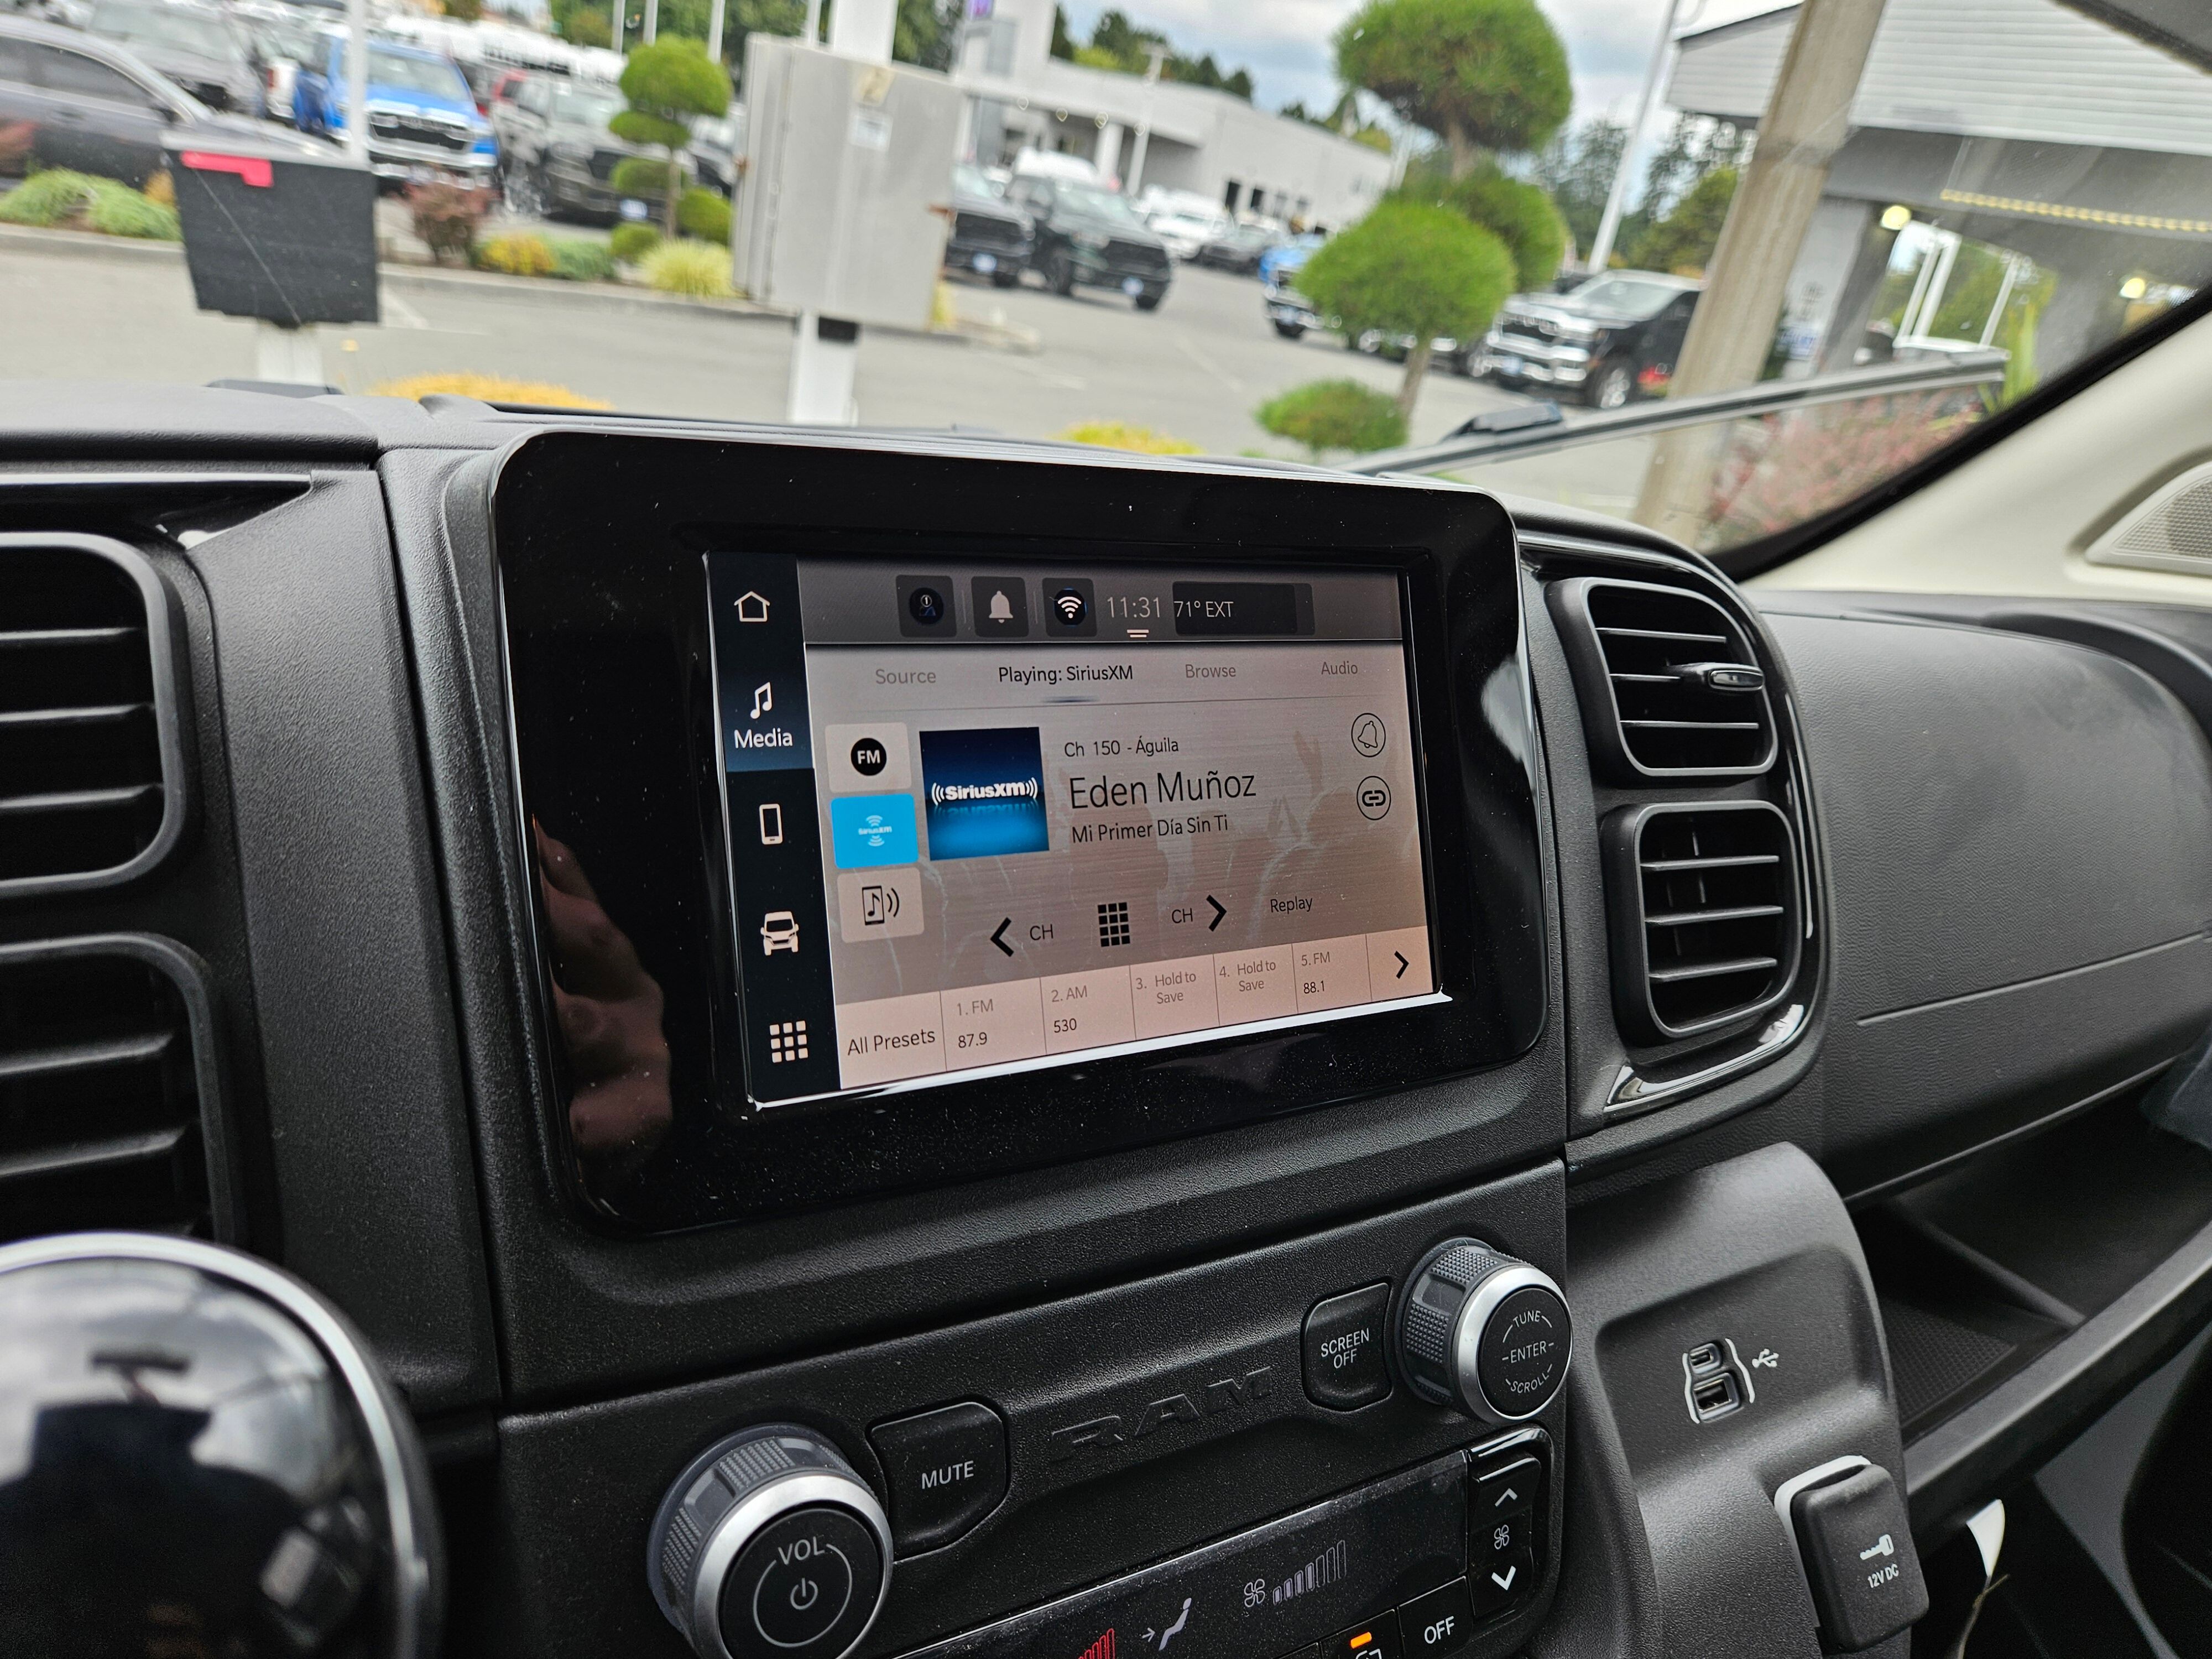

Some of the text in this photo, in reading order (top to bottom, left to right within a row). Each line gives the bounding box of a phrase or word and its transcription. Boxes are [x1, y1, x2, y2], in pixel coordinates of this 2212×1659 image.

[1107, 596, 1162, 618] 11:31
[1173, 601, 1234, 618] 71° EXT
[875, 669, 937, 685] Source
[998, 665, 1134, 685] Playing: SiriusXM
[1185, 663, 1237, 679] Browse
[1321, 660, 1358, 675] Audio
[734, 728, 793, 748] Media
[1064, 741, 1084, 757] Ch
[1093, 740, 1121, 755] 150
[1135, 735, 1179, 757] Águila
[857, 749, 881, 765] FM
[1070, 770, 1257, 809] Eden Muñoz
[1072, 814, 1228, 843] Mi Primer Día Sin Ti
[1270, 895, 1313, 914] Replay
[1171, 908, 1193, 925] CH
[1029, 924, 1054, 941] CH
[1219, 959, 1276, 978] 4. Hold to
[1301, 951, 1331, 967] 5. FM
[1135, 971, 1196, 990] 3. Hold to
[1239, 978, 1265, 993] Save
[1303, 980, 1326, 995] 88.1
[1051, 985, 1088, 1002] 2. AM
[1156, 989, 1184, 1004] Save
[956, 998, 994, 1016] 1. FM
[1053, 1018, 1077, 1034] 530
[847, 1029, 936, 1057] All Presets
[957, 1032, 988, 1049] 87.9
[1513, 1310, 1541, 1328] TUNE
[1320, 1327, 1370, 1358] SCREEN
[1510, 1340, 1547, 1364] ENTER
[1333, 1348, 1358, 1370] OFF
[1510, 1371, 1550, 1394] SCROLL
[1051, 1366, 1272, 1463] RAM
[921, 1460, 975, 1490] MUTE
[778, 1535, 826, 1566] VOL
[1867, 1563, 1899, 1588] 12V DC
[1424, 1615, 1455, 1645] OFF
